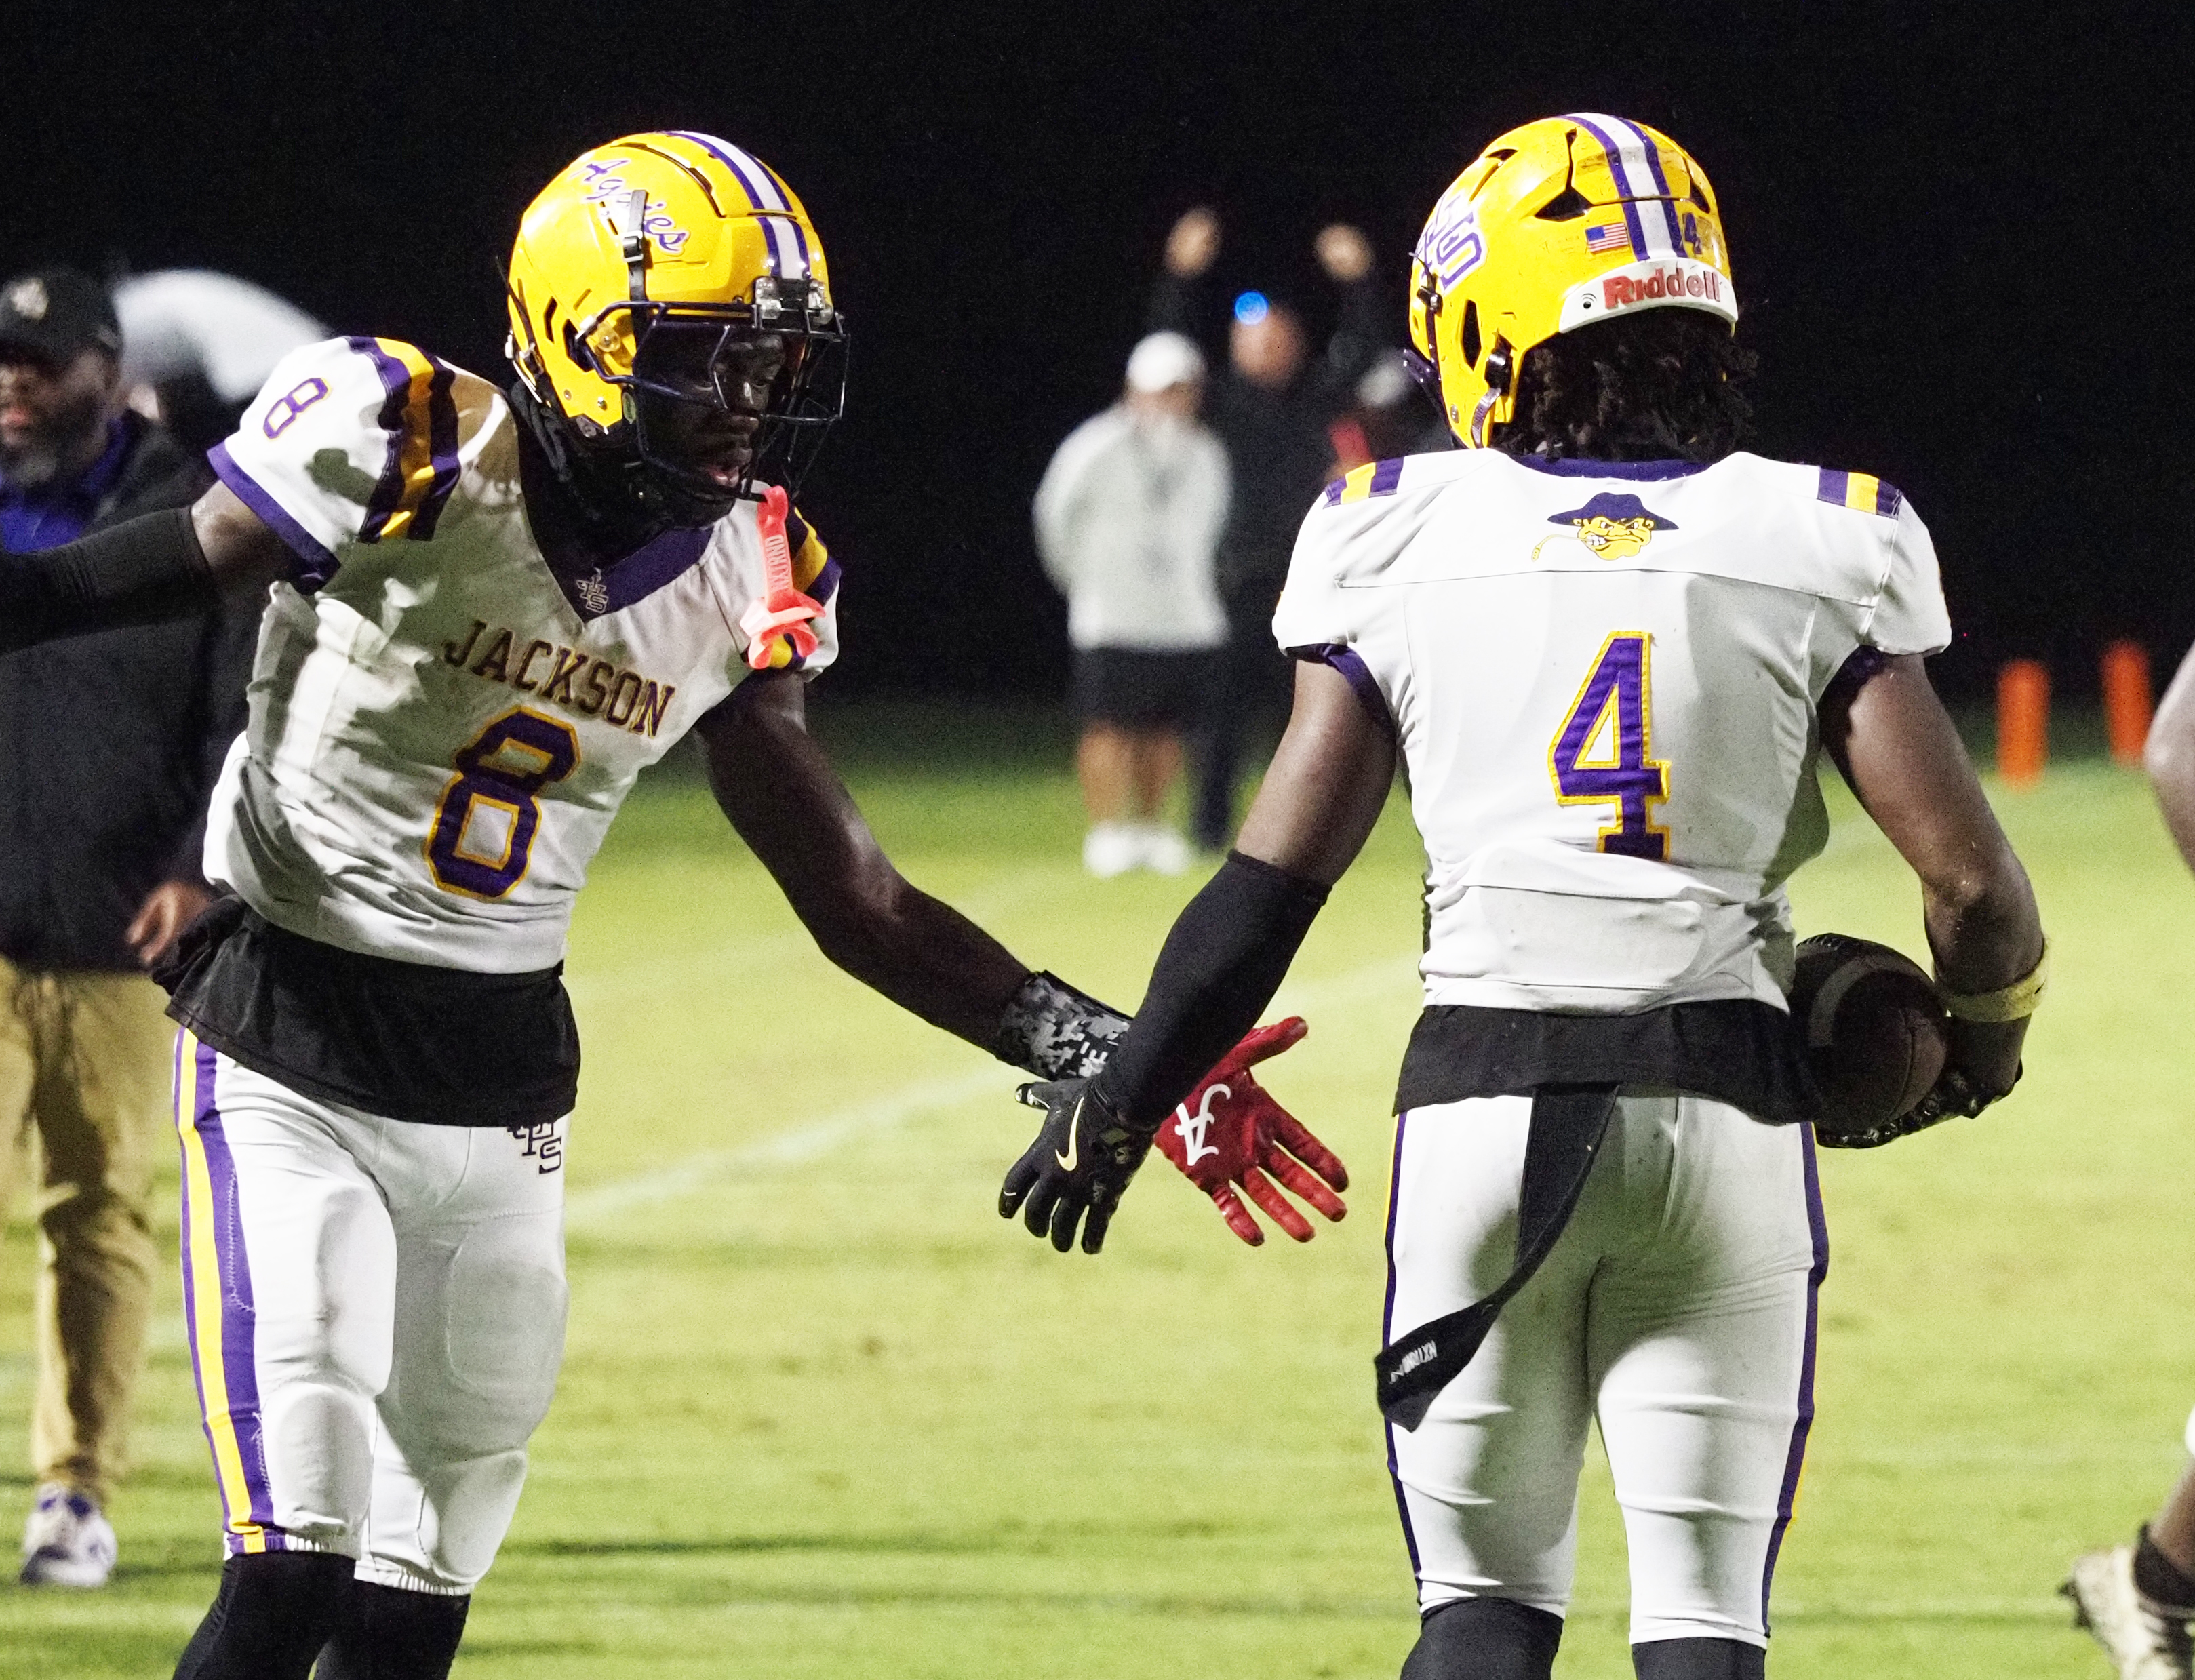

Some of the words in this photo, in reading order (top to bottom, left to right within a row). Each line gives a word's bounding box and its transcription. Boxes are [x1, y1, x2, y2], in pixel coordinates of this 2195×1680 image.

[1603, 266, 1721, 310] Riddell
[263, 377, 332, 440] 8
[443, 620, 675, 738] JACKSON
[422, 704, 582, 900] 8
[1547, 630, 1672, 863] 4
